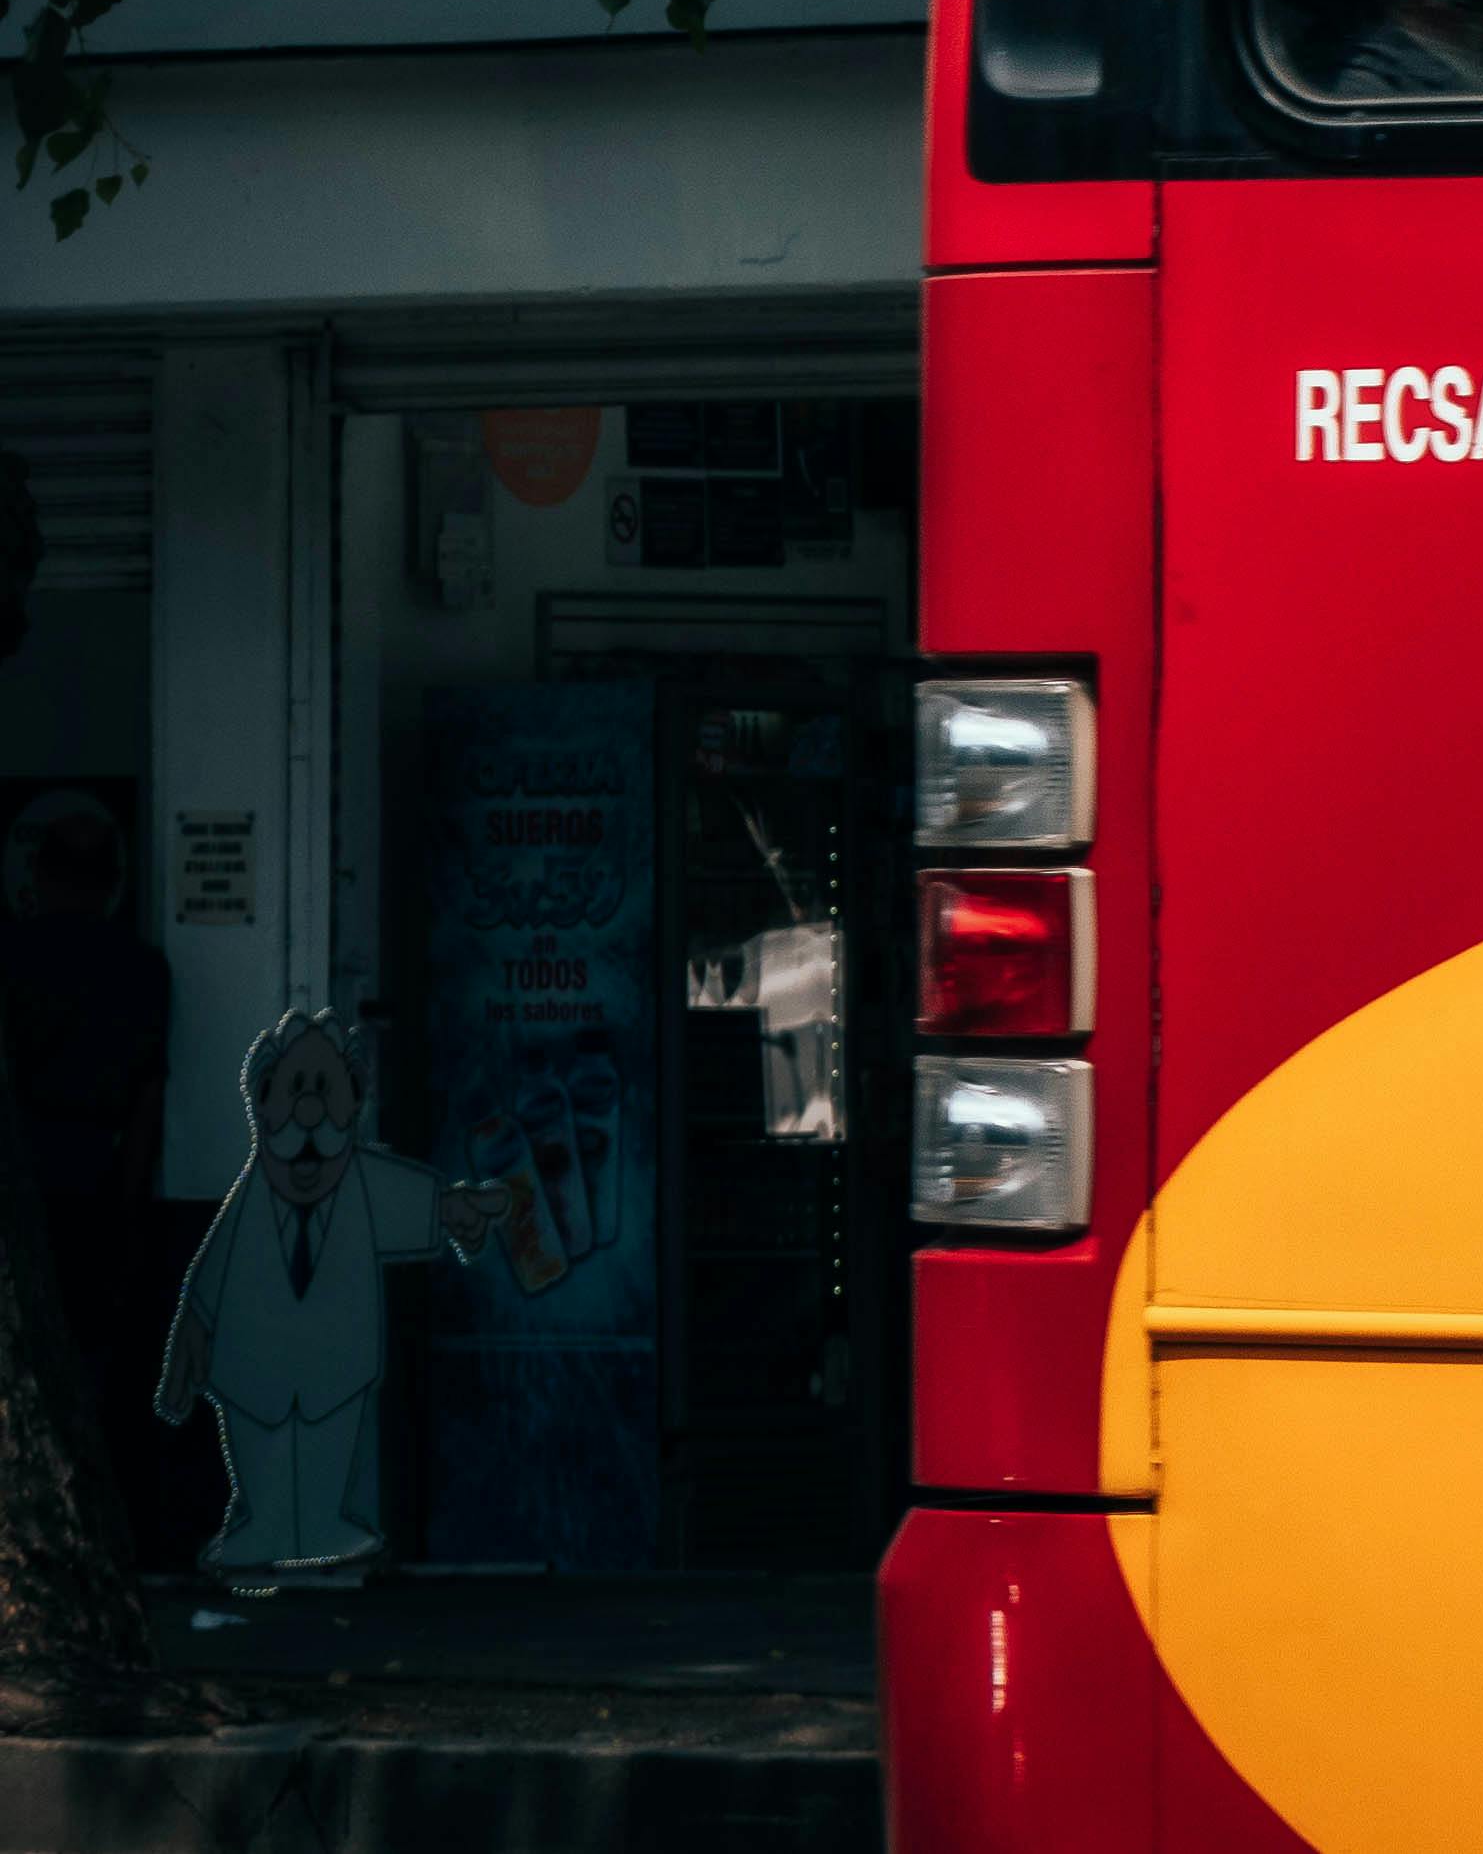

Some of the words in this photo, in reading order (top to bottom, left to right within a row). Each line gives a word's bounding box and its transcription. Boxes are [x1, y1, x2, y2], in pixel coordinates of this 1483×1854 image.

[487, 808, 604, 846] SUEROS
[502, 958, 588, 991] TODOS
[522, 997, 606, 1023] sabores
